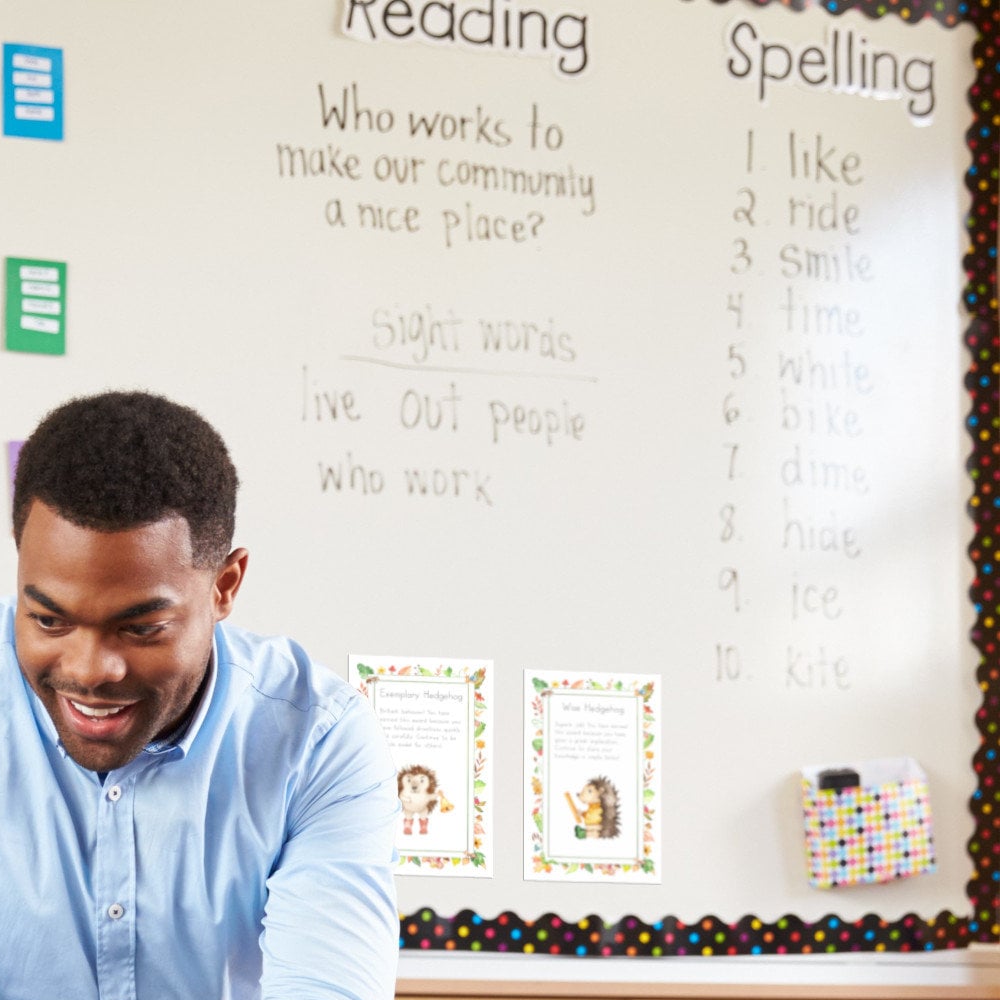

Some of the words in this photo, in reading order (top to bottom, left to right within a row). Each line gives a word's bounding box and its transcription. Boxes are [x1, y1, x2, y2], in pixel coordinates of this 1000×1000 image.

[346, 0, 588, 75] Reading
[728, 21, 935, 117] Spelling
[317, 82, 394, 133] Who
[408, 105, 512, 147] works
[528, 102, 563, 151] to
[276, 142, 362, 181] make
[374, 154, 425, 184] our
[437, 156, 596, 216] community
[788, 130, 864, 186] like
[325, 199, 346, 228] a
[357, 202, 420, 233] nice
[442, 201, 545, 249] place?
[789, 190, 861, 235] ride
[779, 286, 864, 338] time
[479, 317, 578, 362] words
[778, 349, 875, 394] white
[301, 364, 361, 422] live
[489, 399, 586, 447] people
[780, 387, 865, 438] bike
[318, 451, 385, 497] who
[404, 469, 493, 507] work
[780, 444, 870, 494] dime
[791, 570, 844, 621] ice
[785, 644, 851, 691] kite
[423, 690, 463, 703] Hedgehog
